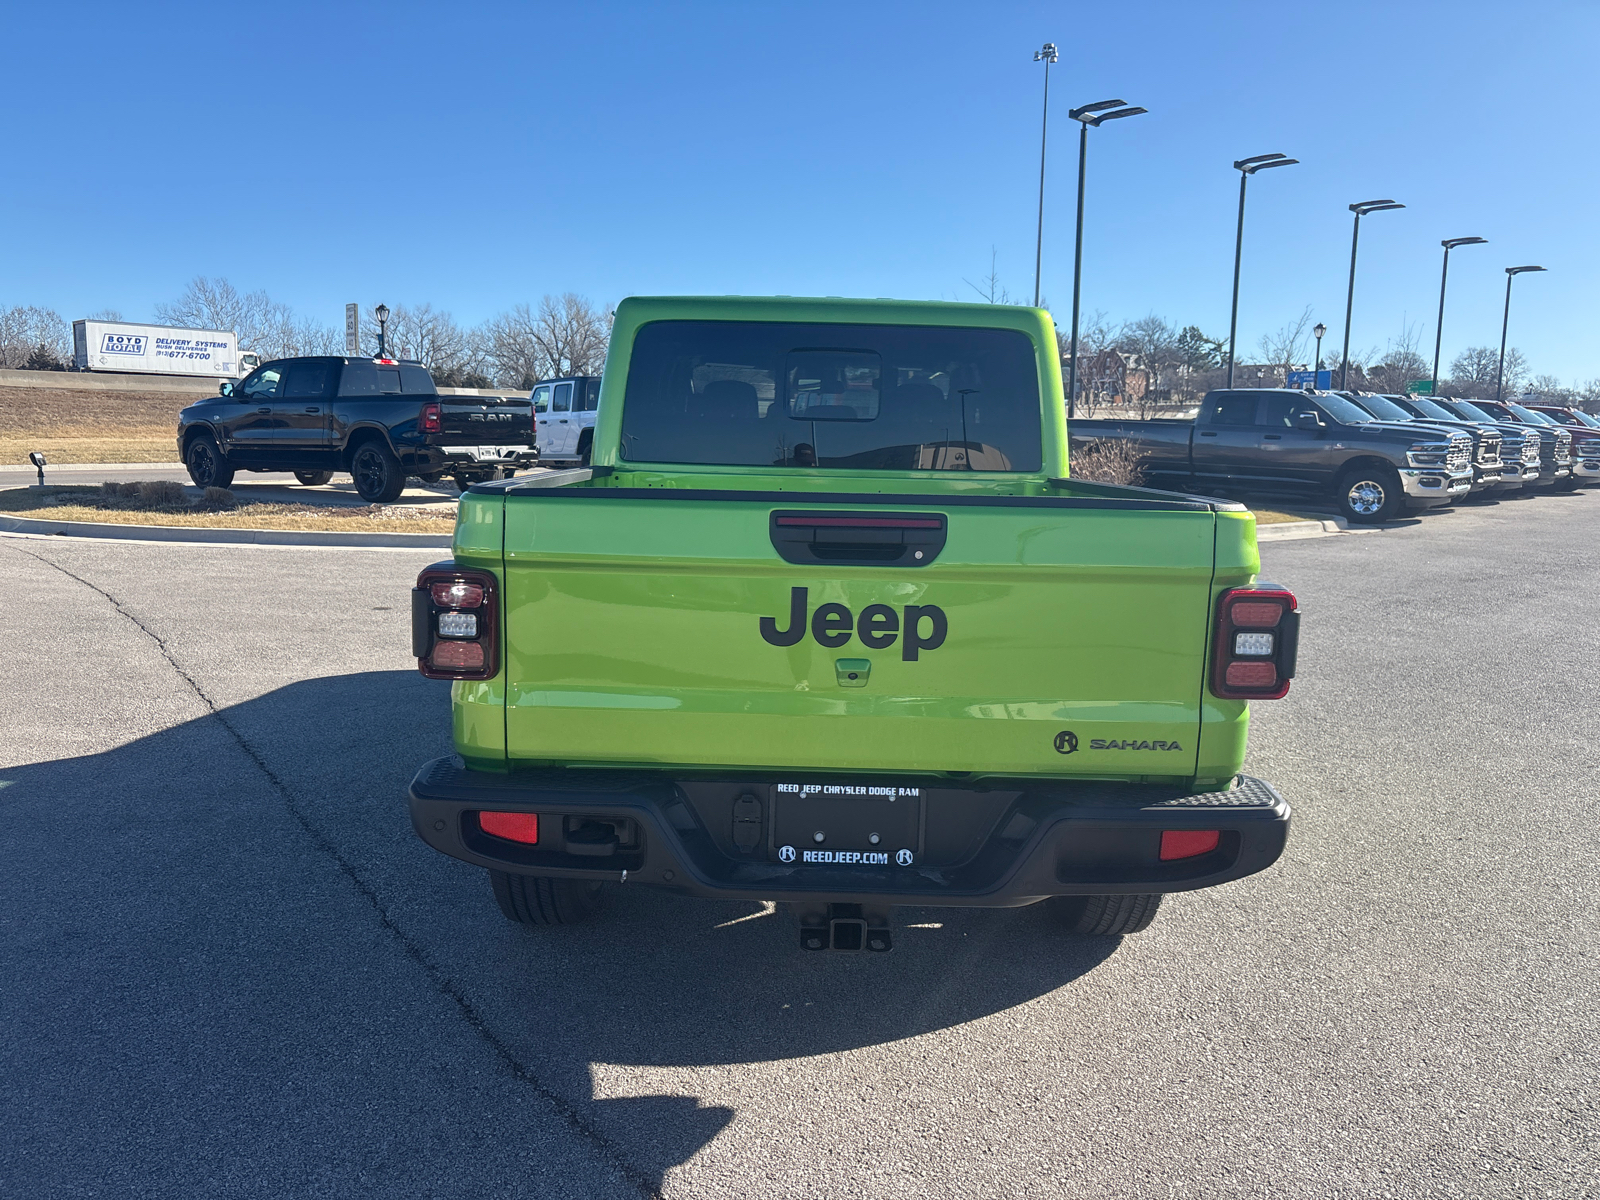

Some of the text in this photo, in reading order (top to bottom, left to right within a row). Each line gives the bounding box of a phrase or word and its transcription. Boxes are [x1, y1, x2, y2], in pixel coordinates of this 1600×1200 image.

[107, 335, 142, 345] BOYD
[155, 337, 228, 349] DELIVERY SYSTEMS
[107, 343, 140, 352] TOTAL
[470, 413, 512, 422] RAM
[759, 586, 948, 662] Jeep
[1089, 739, 1183, 751] SAHARA
[777, 783, 919, 797] REED JEEP CHRYSLER DODGE RAM
[803, 850, 888, 865] REEDJEEP.COM
